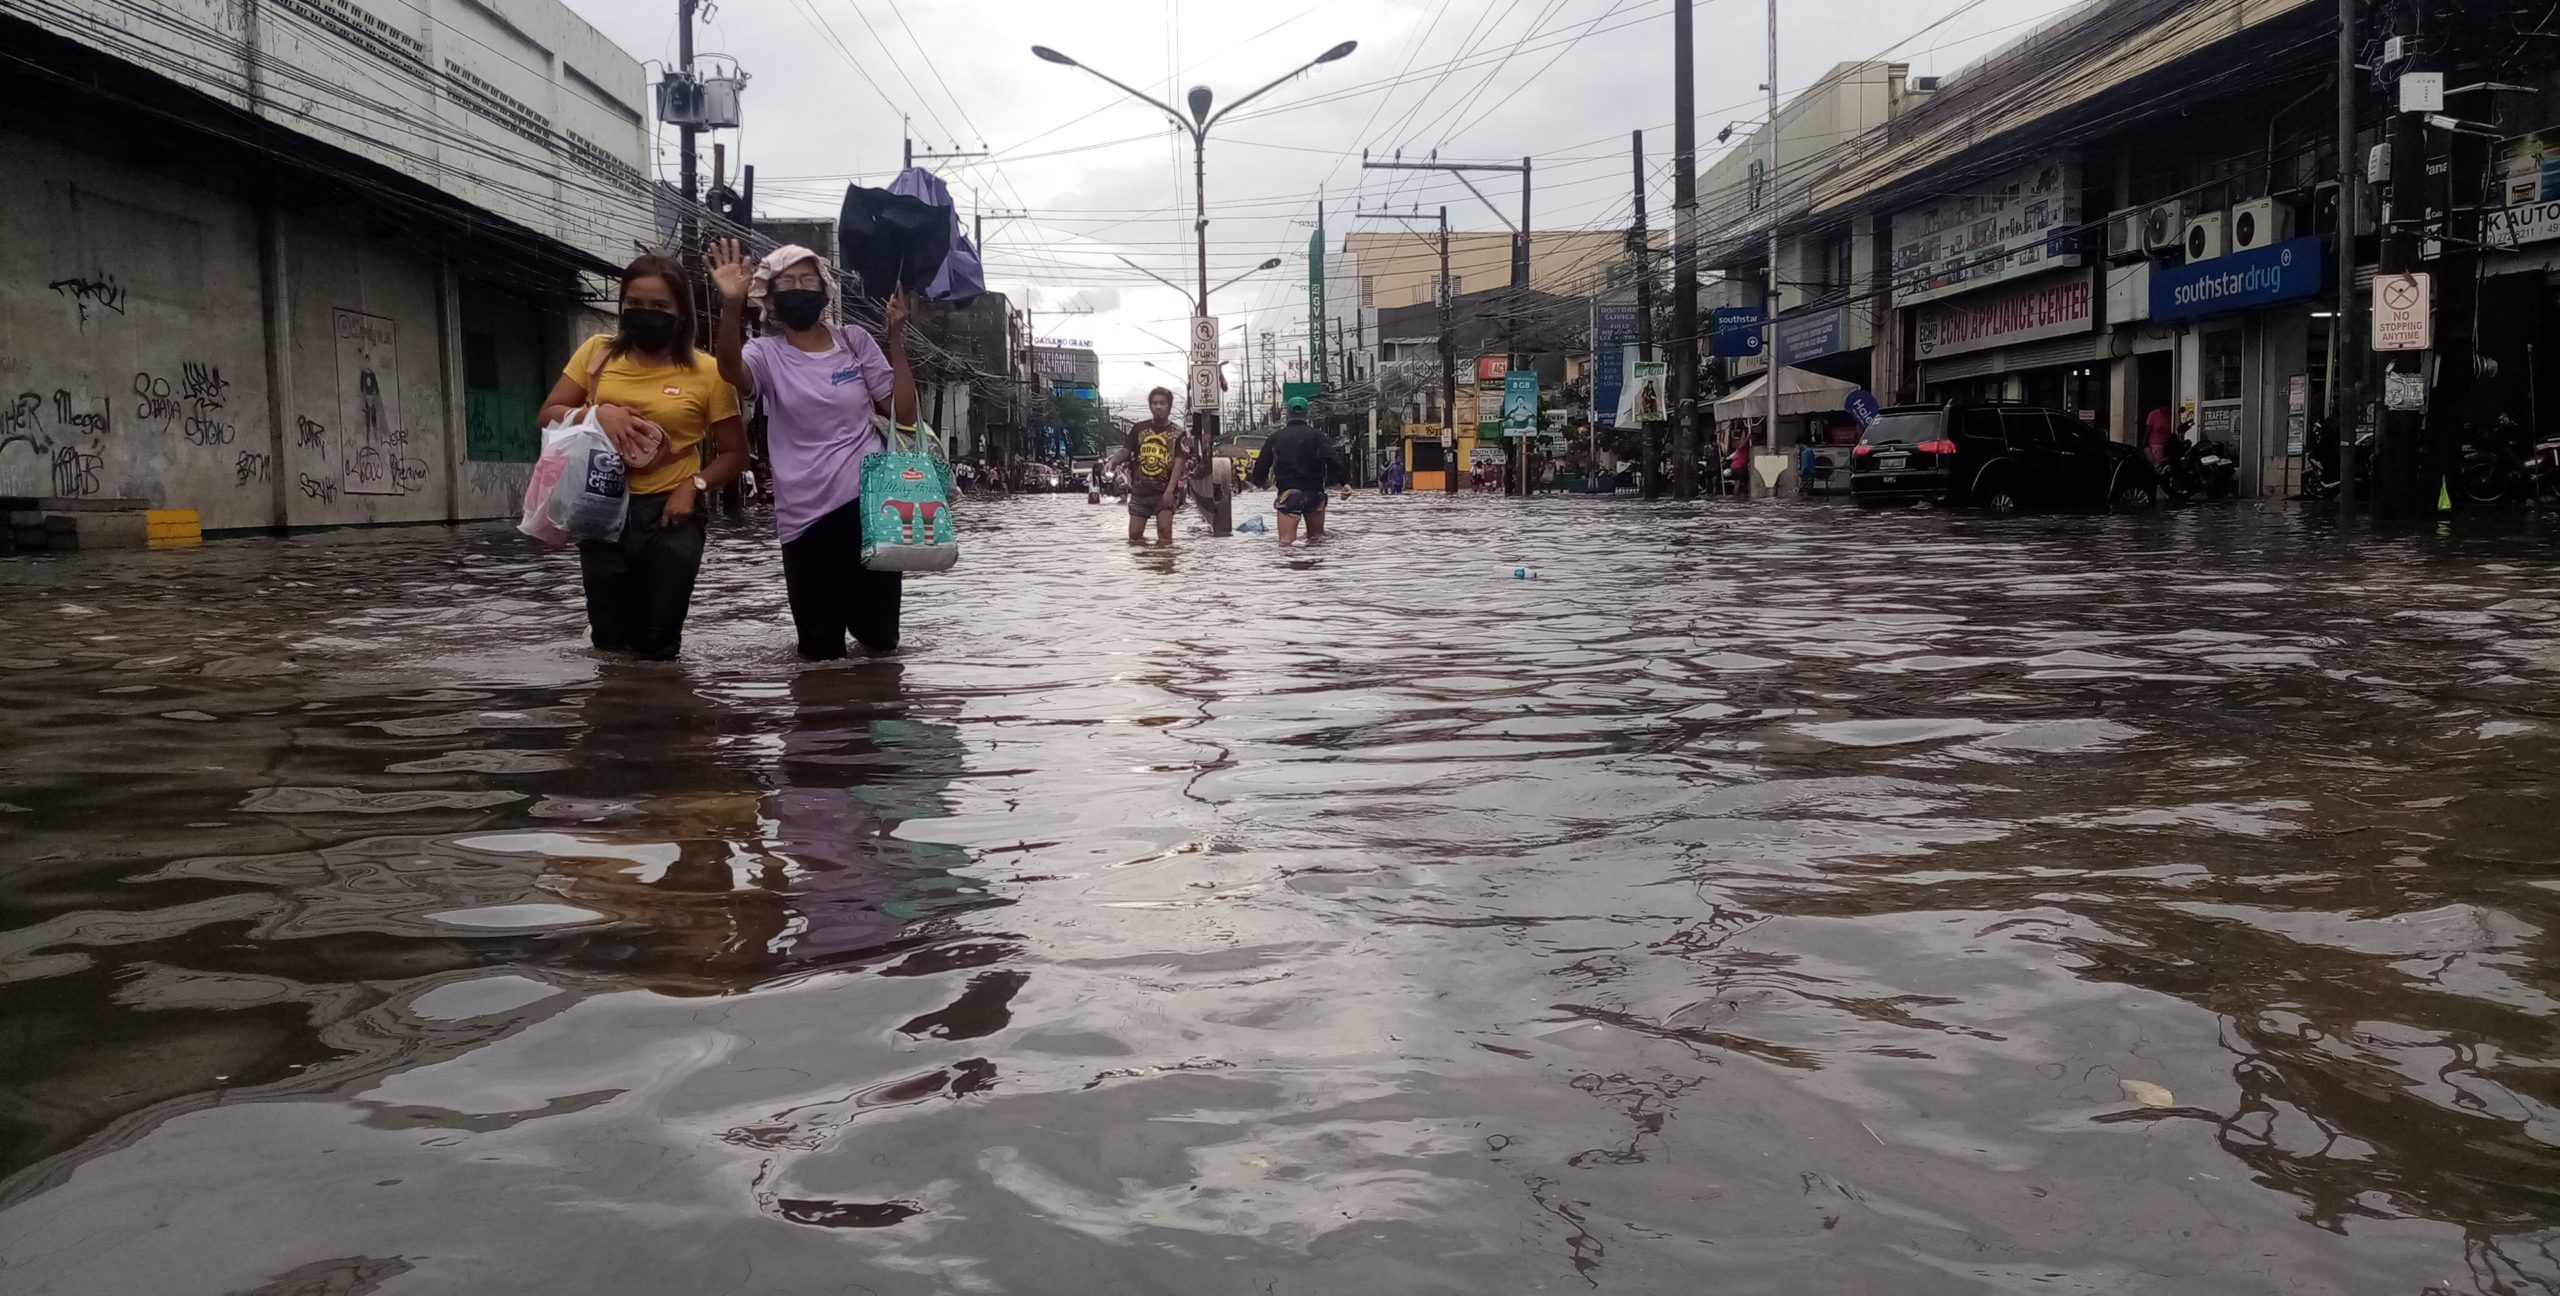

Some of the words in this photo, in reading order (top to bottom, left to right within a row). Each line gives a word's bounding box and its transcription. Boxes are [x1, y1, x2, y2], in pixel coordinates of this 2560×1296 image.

[2506, 203, 2560, 227] AUTO
[2174, 271, 2244, 305] southstar
[2245, 264, 2281, 294] drug
[1940, 312, 1968, 346] ECHO
[1970, 293, 2034, 340] APPLIANCE
[2039, 280, 2089, 327] CENTER
[2393, 311, 2410, 321] NO
[1718, 314, 1758, 324] southstar
[2380, 321, 2423, 332] STOPPING
[1919, 322, 1938, 343] ECHO
[2382, 331, 2419, 341] ANYTIME
[1193, 342, 1206, 351] NO
[1210, 342, 1217, 351] U
[1195, 351, 1216, 359] TURN
[1852, 398, 1875, 426] Haie
